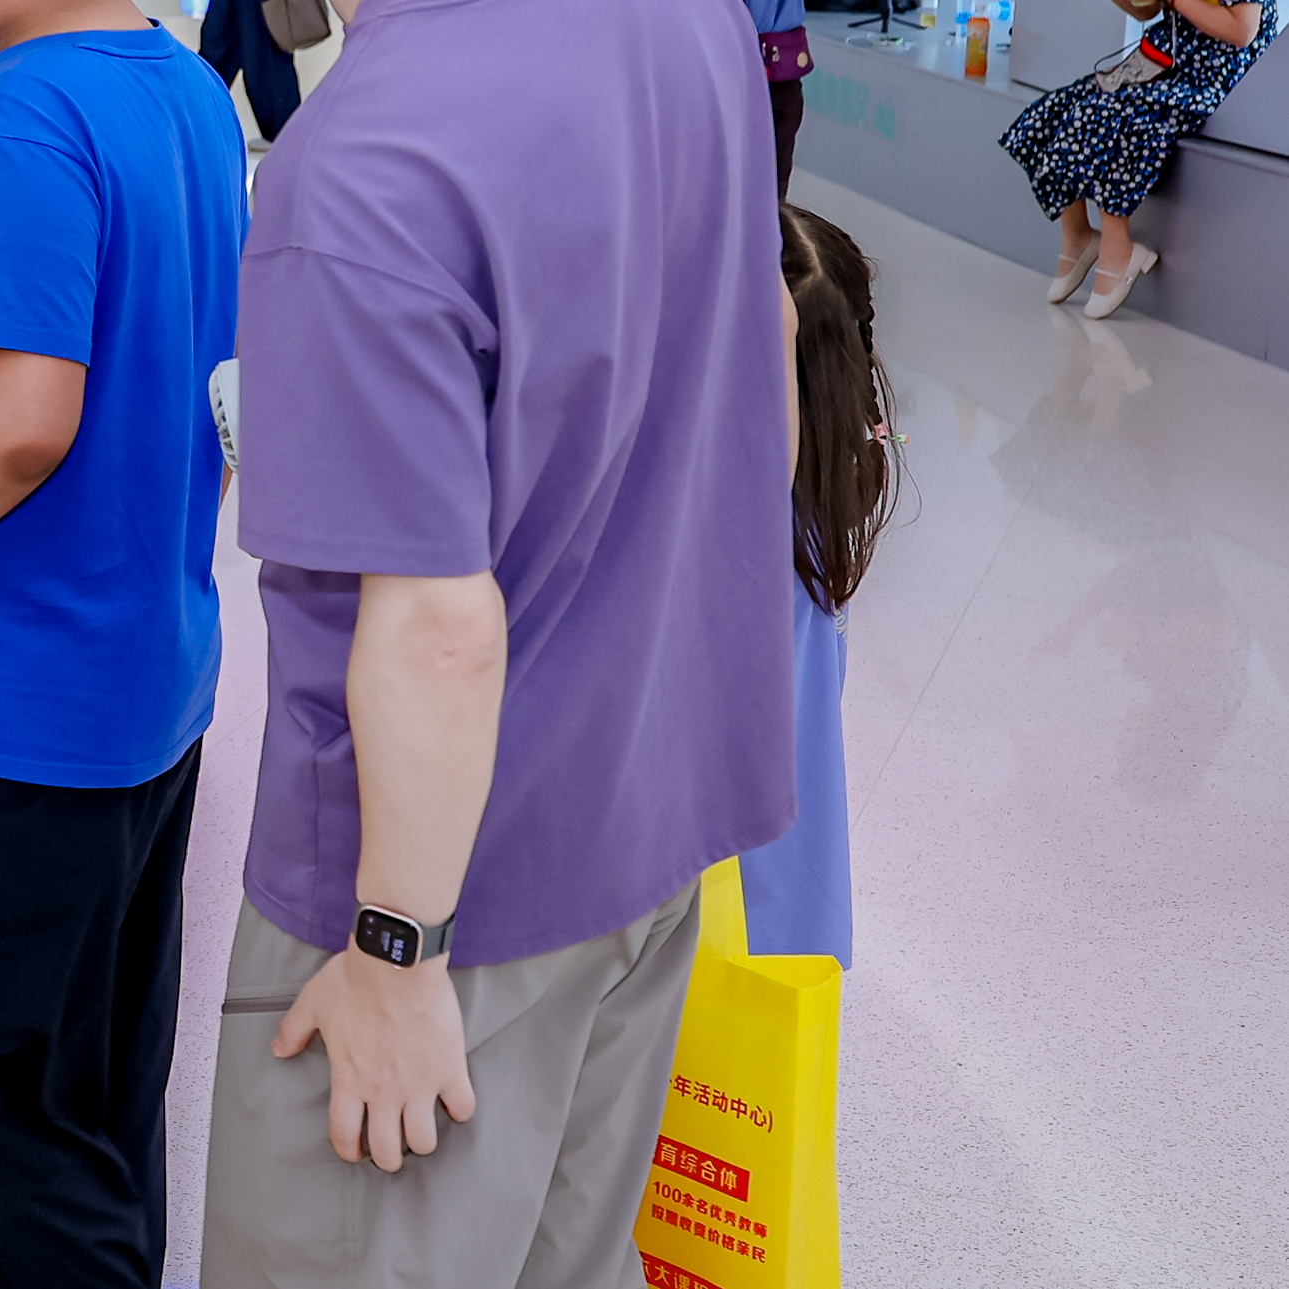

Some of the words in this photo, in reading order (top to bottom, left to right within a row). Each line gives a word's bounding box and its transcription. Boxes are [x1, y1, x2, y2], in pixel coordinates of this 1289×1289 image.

[670, 1075, 773, 1133] 年活动中心)
[661, 1142, 737, 1191] 育综合体
[653, 1181, 767, 1239] 100余名优秀教师
